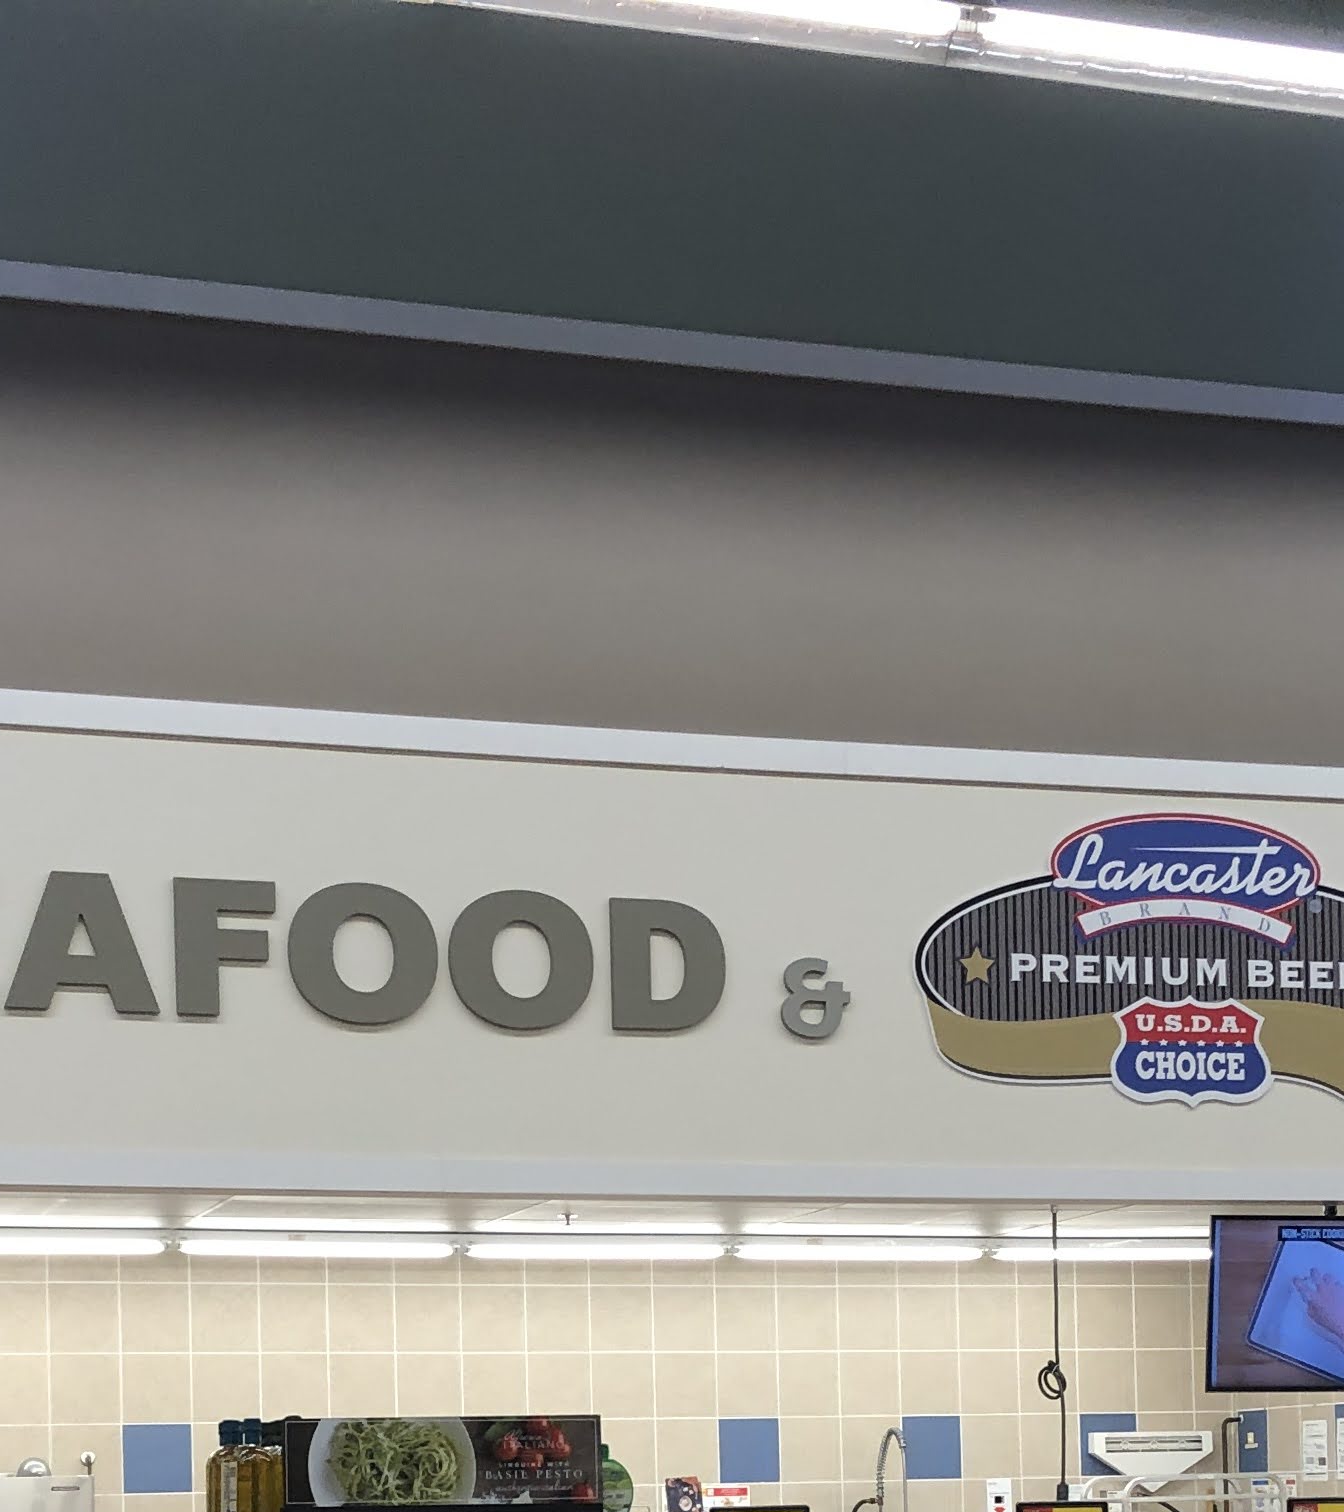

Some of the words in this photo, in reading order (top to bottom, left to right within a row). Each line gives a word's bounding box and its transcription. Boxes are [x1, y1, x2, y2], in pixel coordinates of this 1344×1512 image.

[1053, 834, 1314, 897] Lancaster
[1098, 900, 1274, 935] BRAND
[1011, 953, 1227, 988] PREMIUM
[780, 957, 851, 1040] &
[1136, 1014, 1247, 1034] U.S.D.A.
[1136, 1050, 1245, 1082] CHOICE
[485, 1470, 528, 1480] BASIL
[536, 1469, 583, 1479] PESTO
